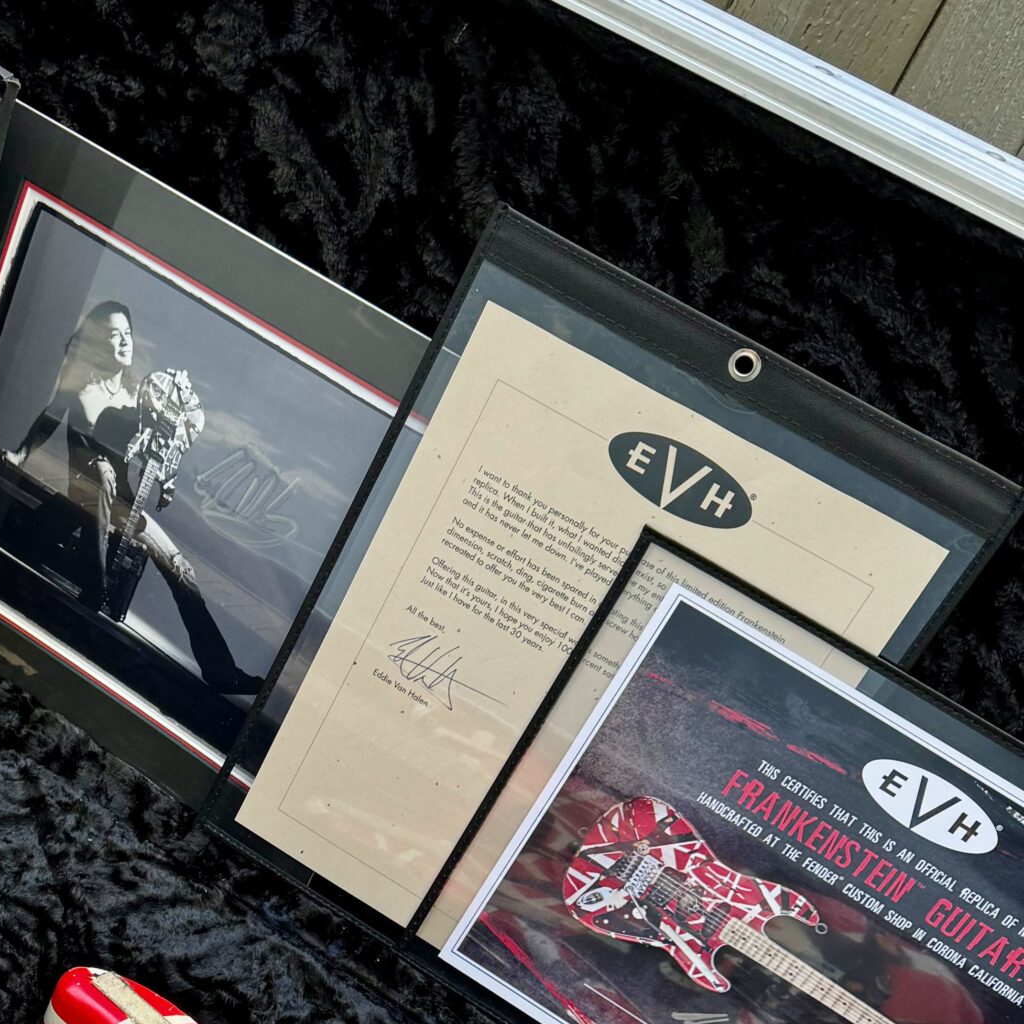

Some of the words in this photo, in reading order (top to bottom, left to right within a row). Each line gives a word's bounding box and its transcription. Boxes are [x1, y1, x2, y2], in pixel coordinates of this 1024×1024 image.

[447, 527, 484, 555] dimension,
[487, 551, 513, 572] scratch,
[516, 567, 534, 584] ding,
[537, 580, 569, 601] cigarette
[570, 596, 588, 612] burn
[452, 516, 464, 529] No
[465, 526, 495, 546] expense
[496, 544, 505, 552] or
[506, 549, 526, 564] effort
[526, 558, 540, 572] has
[541, 567, 560, 583] been
[562, 581, 589, 599] spared
[589, 595, 597, 604] in
[630, 619, 643, 631] this
[462, 498, 479, 510] and
[478, 505, 485, 513] it
[485, 508, 498, 522] has
[499, 520, 520, 534] never
[521, 529, 531, 540] let
[532, 538, 544, 548] me
[545, 544, 567, 562] down.
[570, 557, 584, 570] I've
[584, 568, 614, 586] played
[469, 485, 482, 503] This
[483, 495, 490, 504] is
[491, 500, 503, 511] the
[503, 509, 526, 524] guitar
[527, 520, 542, 533] that
[542, 528, 556, 542] has
[558, 539, 598, 565] unfailingly
[637, 584, 650, 596] my
[473, 478, 499, 497] replica.
[503, 492, 525, 511] When
[530, 507, 548, 523] built
[558, 526, 578, 540] what
[583, 540, 613, 559] wanted
[634, 568, 654, 585] exist,
[656, 582, 667, 591] so
[483, 470, 502, 484] want
[502, 480, 510, 489] to
[511, 484, 532, 501] thank
[532, 498, 548, 510] you
[547, 507, 588, 533] personally
[588, 527, 600, 539] for
[599, 536, 619, 549] your
[666, 571, 679, 584] this
[680, 579, 709, 600] limited
[708, 597, 736, 616] edition
[736, 611, 786, 645] Frankenstein
[406, 605, 417, 615] All
[417, 611, 429, 622] the
[429, 617, 445, 634] best,
[420, 576, 435, 588] Just
[435, 583, 448, 596] like
[453, 593, 471, 609] have
[471, 604, 482, 615] for
[483, 612, 495, 623] the
[496, 618, 510, 631] last
[510, 627, 522, 639] 30
[521, 636, 543, 652] years.
[426, 566, 445, 584] Now
[445, 577, 460, 590] that
[460, 586, 470, 597] it's
[470, 594, 492, 611] yours,
[499, 607, 518, 624] hope
[517, 622, 533, 633] you
[534, 631, 555, 646] enjoy
[432, 556, 461, 580] Offering
[462, 574, 474, 586] this
[474, 584, 497, 601] guitar,
[500, 596, 508, 606] in
[509, 602, 522, 614] this
[523, 611, 540, 625] very
[540, 621, 568, 639] special
[441, 538, 477, 561] recreated
[476, 557, 484, 566] to
[485, 564, 502, 576] offer
[502, 574, 517, 585] you
[518, 581, 530, 592] the
[532, 590, 548, 604] very
[549, 598, 566, 612] best
[570, 613, 585, 625] can.
[373, 668, 392, 685] Eddie
[394, 681, 407, 694] Van
[407, 690, 428, 707] Halen
[758, 760, 781, 780] THIS
[781, 776, 827, 809] CERTIFIES
[829, 804, 858, 827] THAT
[859, 823, 883, 843] THIS
[882, 838, 896, 852] IS
[896, 848, 915, 863] AN
[915, 859, 957, 892] OFFICIAL
[959, 887, 1000, 919] REPLICA
[1001, 915, 1019, 928] OF
[879, 769, 981, 843] EVH
[696, 791, 763, 837] HANDCRAFTED
[762, 834, 781, 847] AT
[781, 843, 802, 862] THE
[842, 883, 885, 914] CUSTOM
[884, 910, 912, 930] SHOP
[912, 928, 927, 941] IN
[926, 937, 967, 968] CORONA
